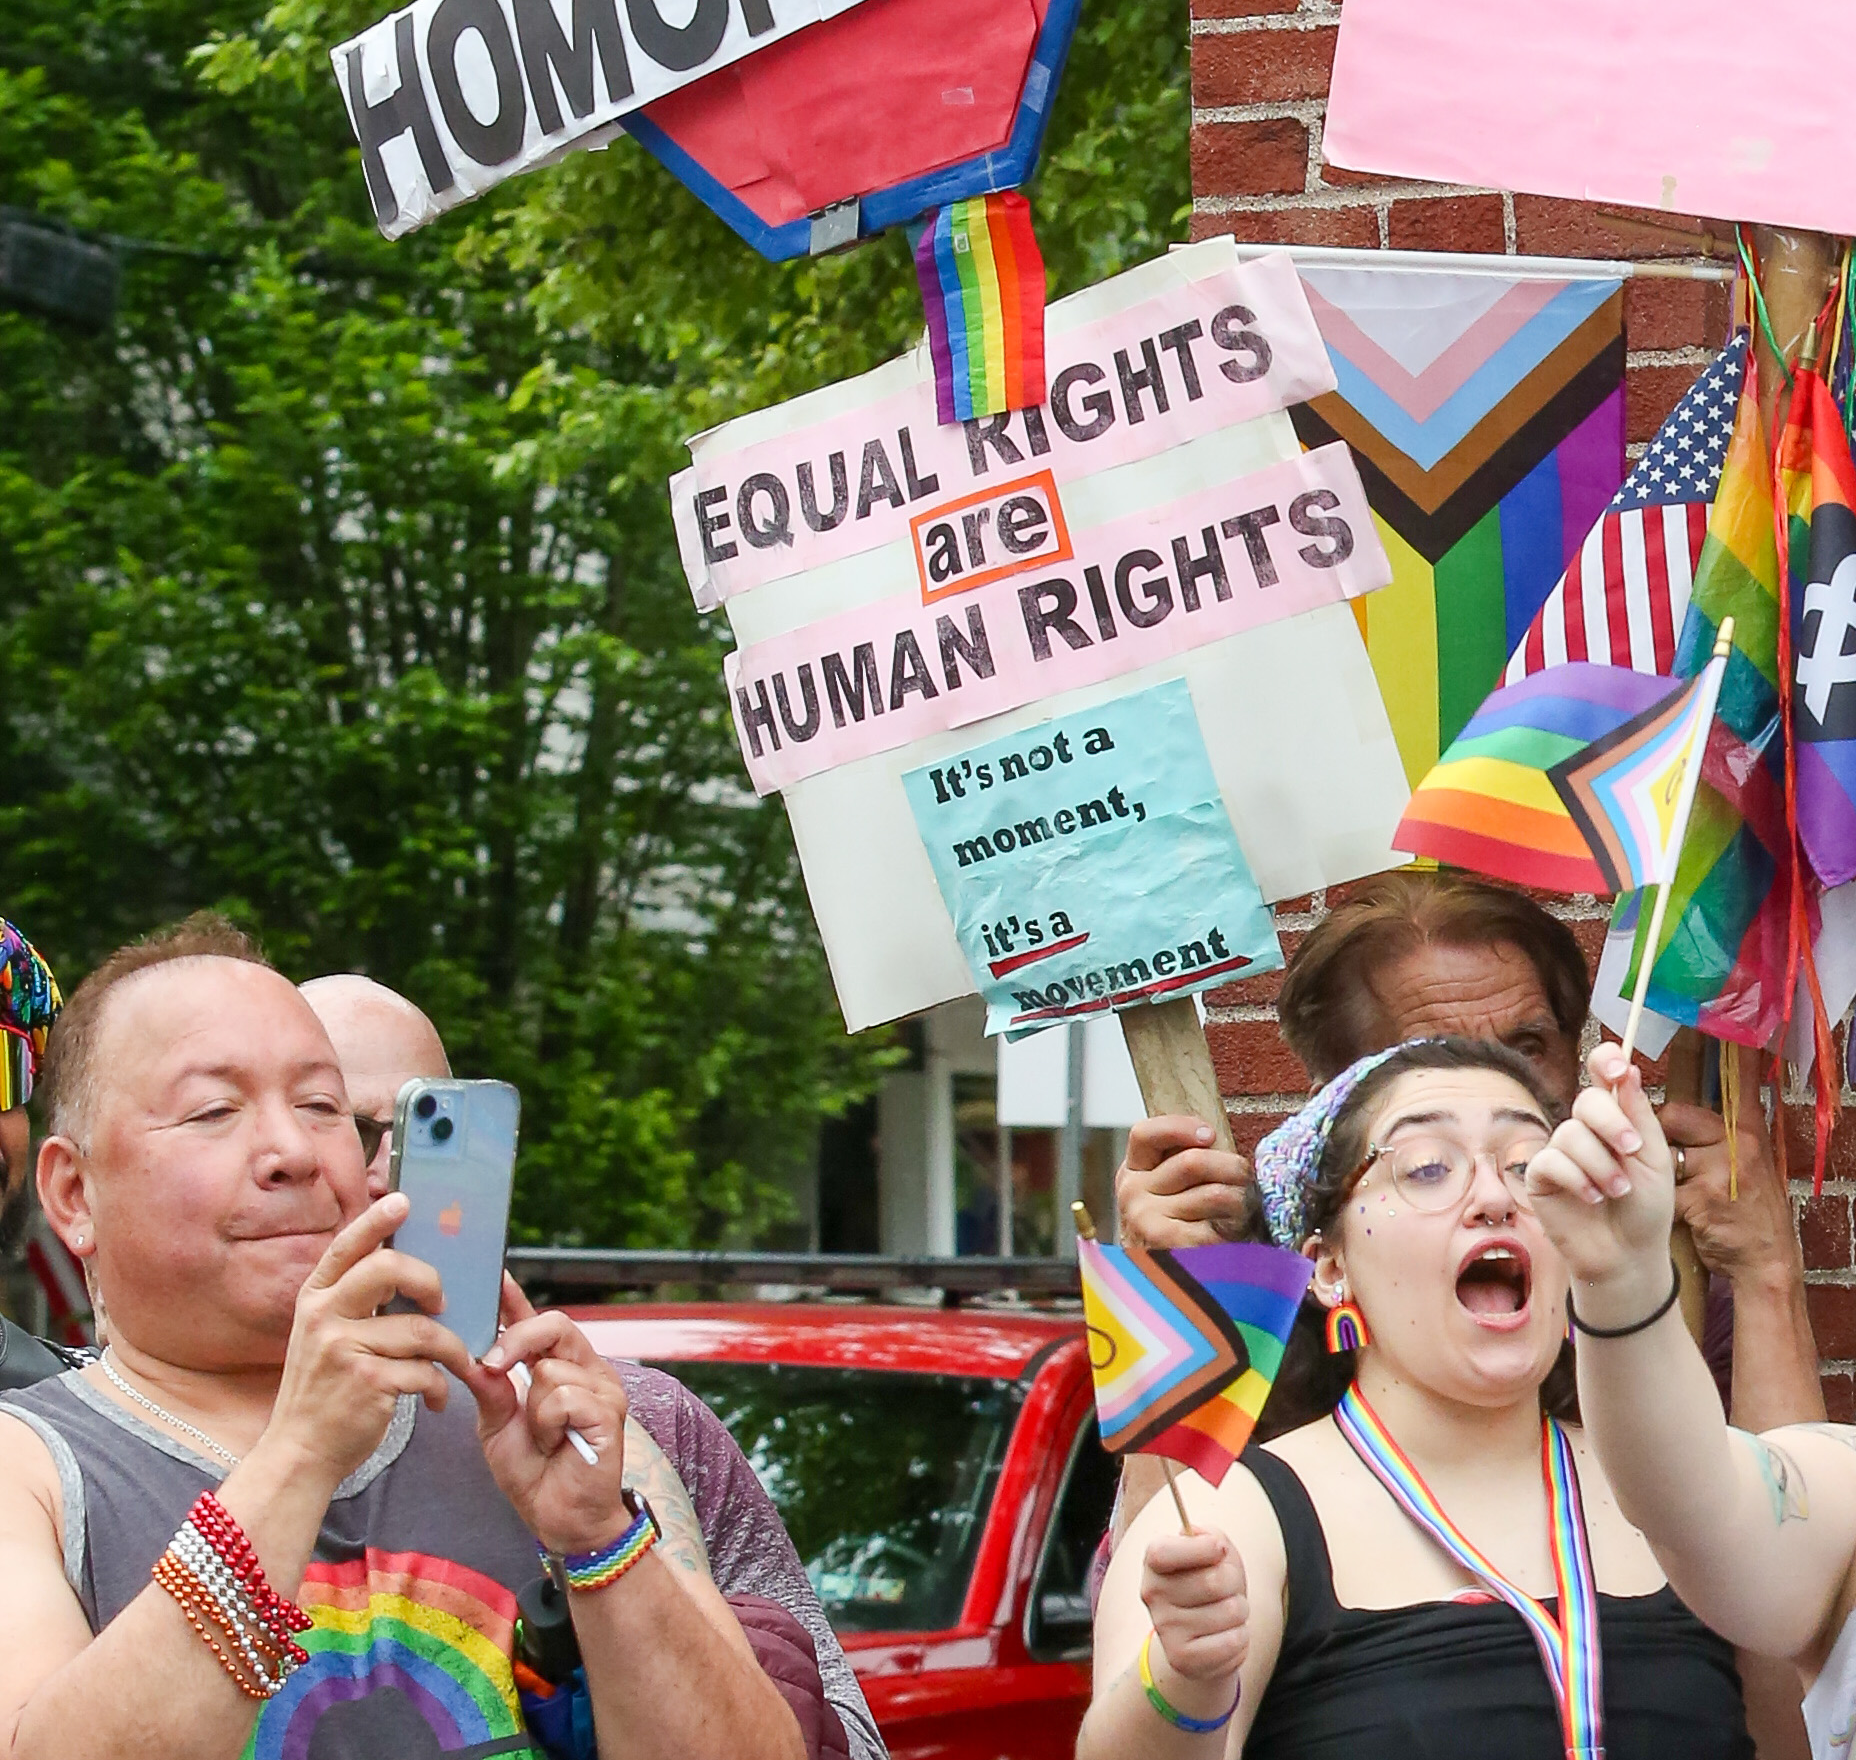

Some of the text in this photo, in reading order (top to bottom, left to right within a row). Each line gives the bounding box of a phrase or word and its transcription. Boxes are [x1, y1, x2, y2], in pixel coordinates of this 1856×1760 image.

[695, 305, 1274, 565] EQUAL RIGHTS
[927, 491, 1048, 581] are
[737, 490, 1354, 757] HUMAN RIGHTS
[929, 724, 1115, 804] It's not a
[954, 783, 1146, 869] moment,
[981, 908, 1074, 957] it's a
[1010, 927, 1230, 1013] movement
